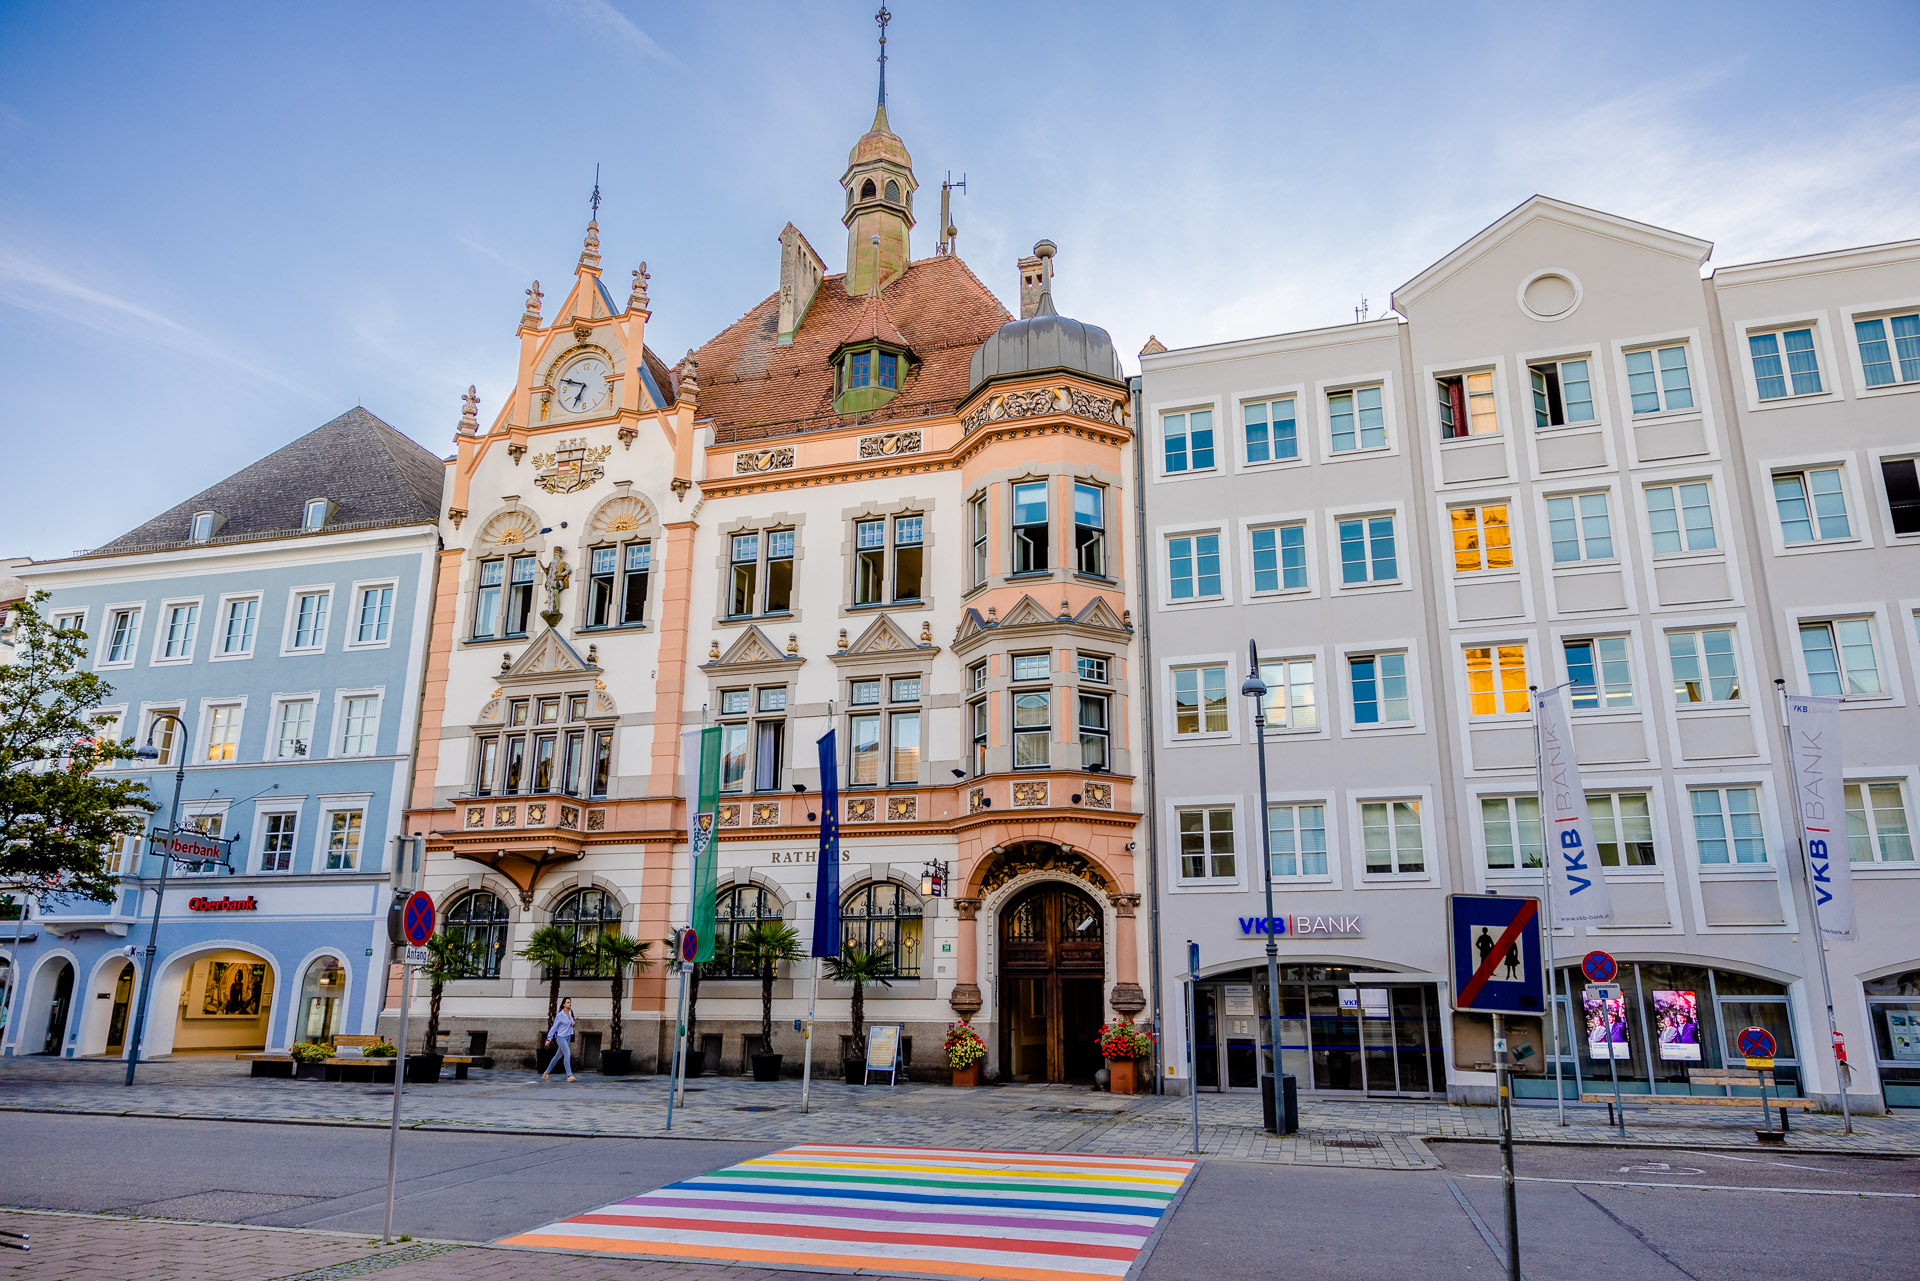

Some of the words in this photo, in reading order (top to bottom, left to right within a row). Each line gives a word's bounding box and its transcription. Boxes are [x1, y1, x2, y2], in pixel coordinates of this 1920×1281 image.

[583, 362, 591, 370] 12
[582, 402, 587, 410] 6
[1545, 723, 1573, 811] BANK
[1801, 730, 1825, 820] BANK
[771, 849, 850, 864] RATHUS
[1560, 829, 1591, 896] VKB
[1809, 839, 1832, 906] VKB
[188, 896, 257, 911] Oberbank
[1238, 917, 1286, 934] VKB
[1297, 916, 1361, 933] BANK
[406, 947, 427, 963] Anfang
